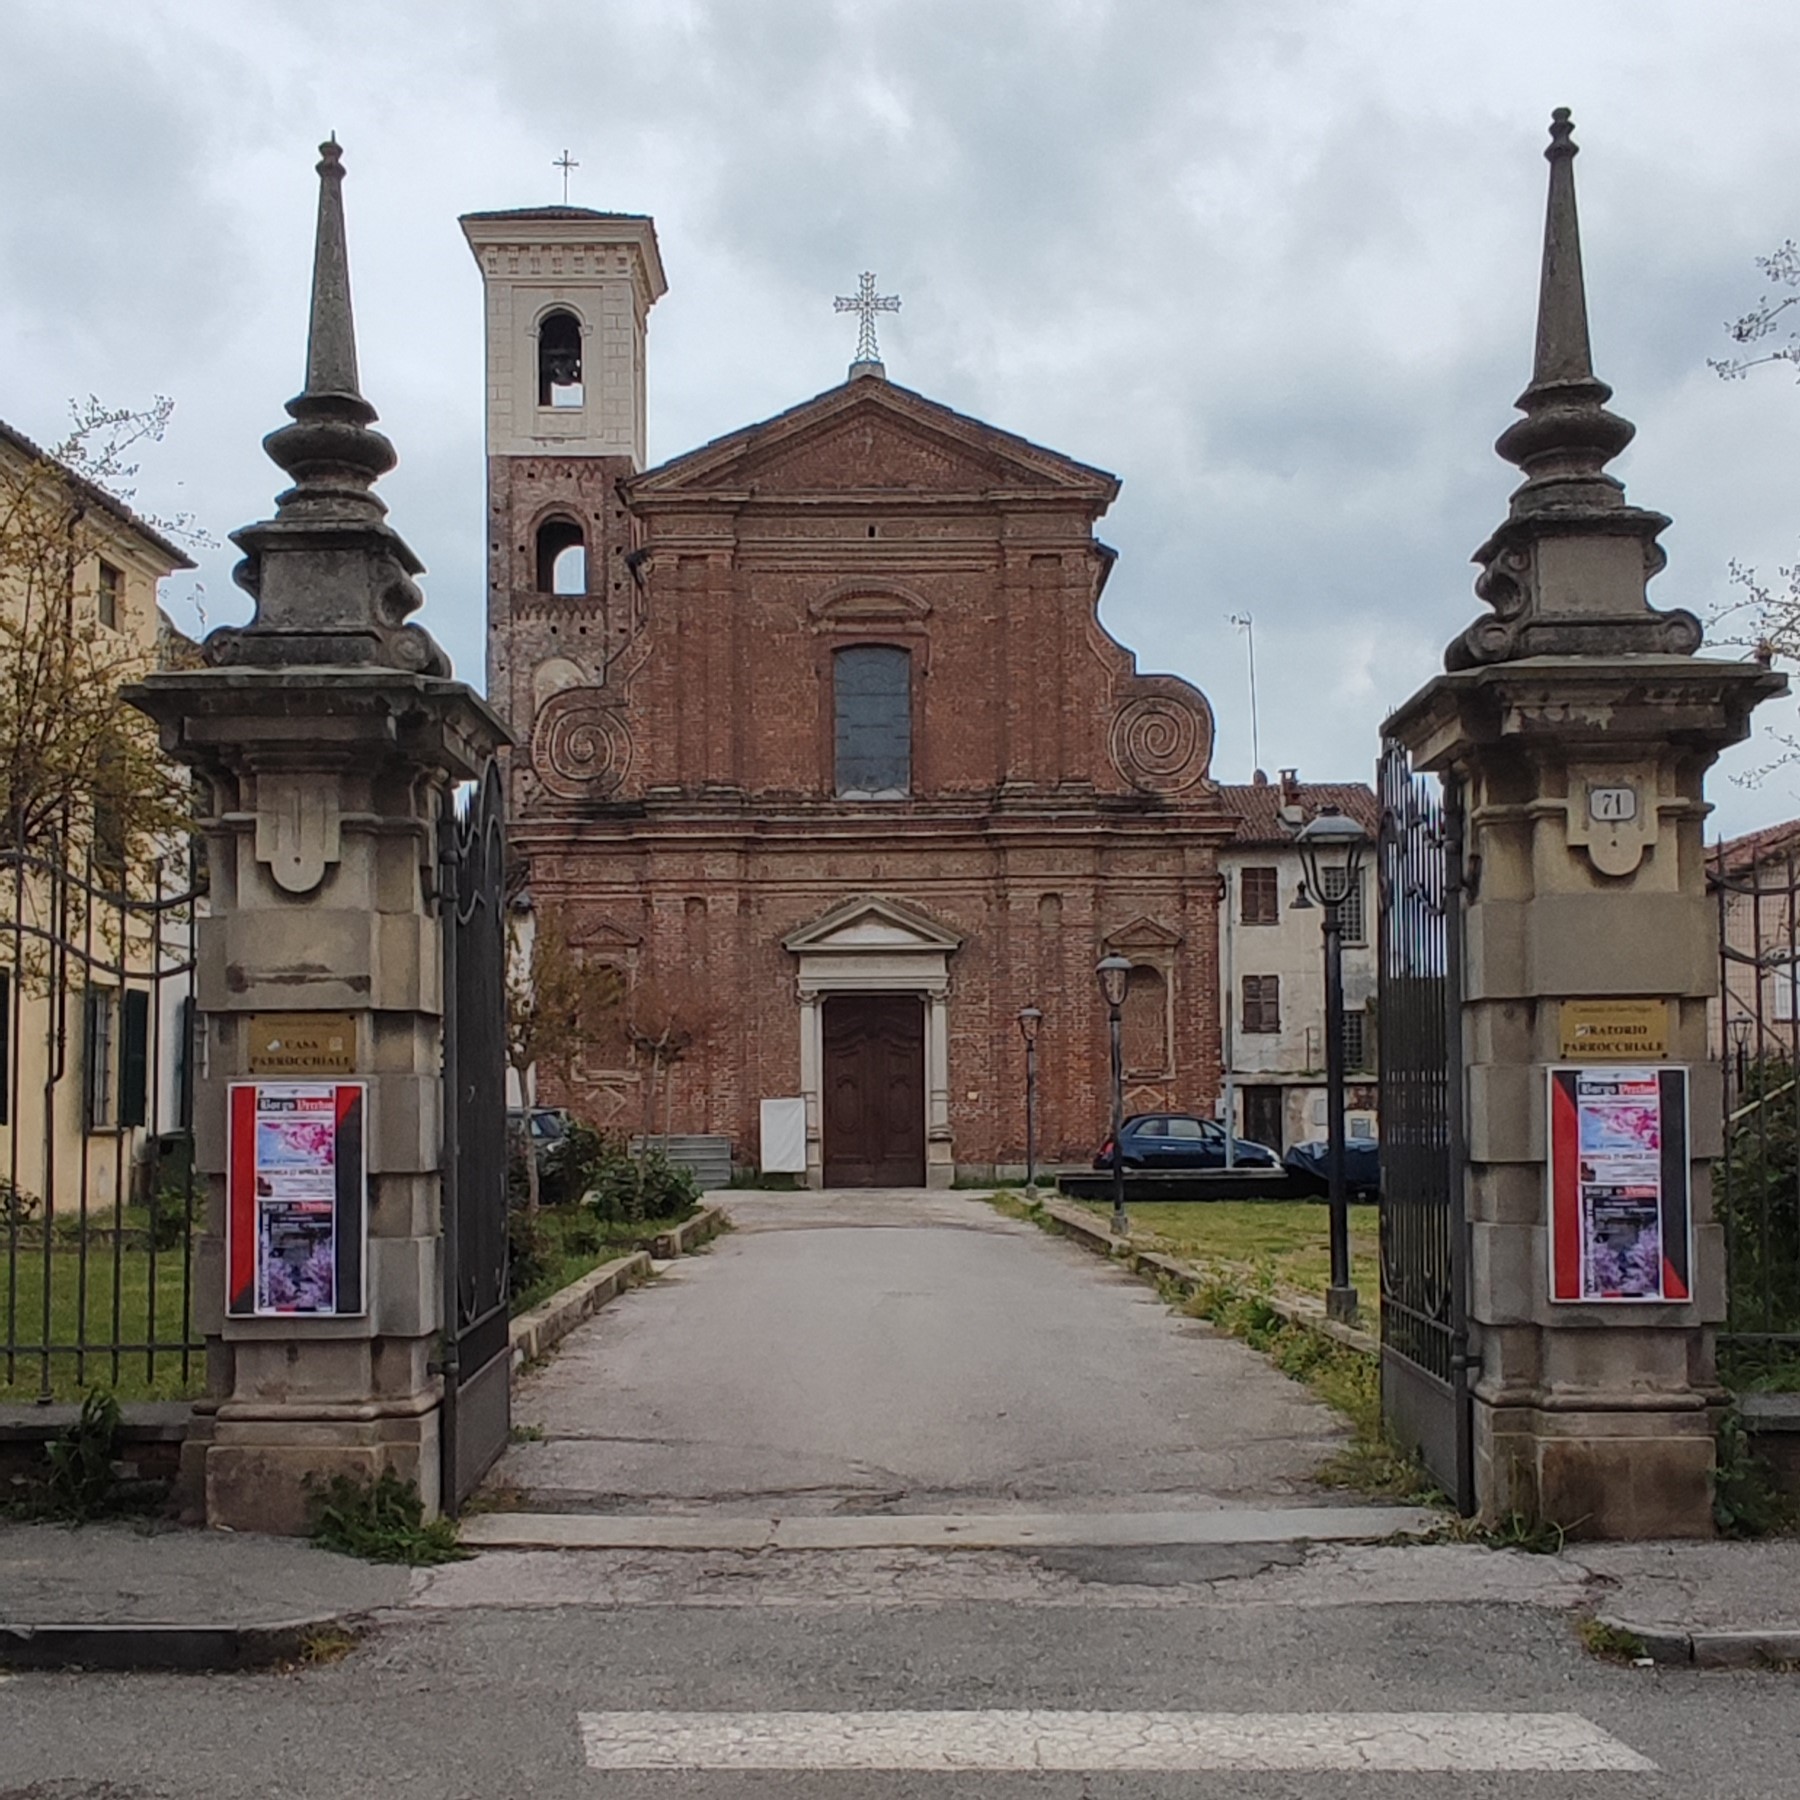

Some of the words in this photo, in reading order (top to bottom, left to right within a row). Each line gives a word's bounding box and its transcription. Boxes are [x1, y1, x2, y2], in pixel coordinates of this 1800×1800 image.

[1603, 793, 1621, 815] 71
[285, 1040, 318, 1050] CASA
[1563, 1043, 1662, 1052] PARROCCHIALE
[251, 1056, 349, 1066] PARROCCHIALE
